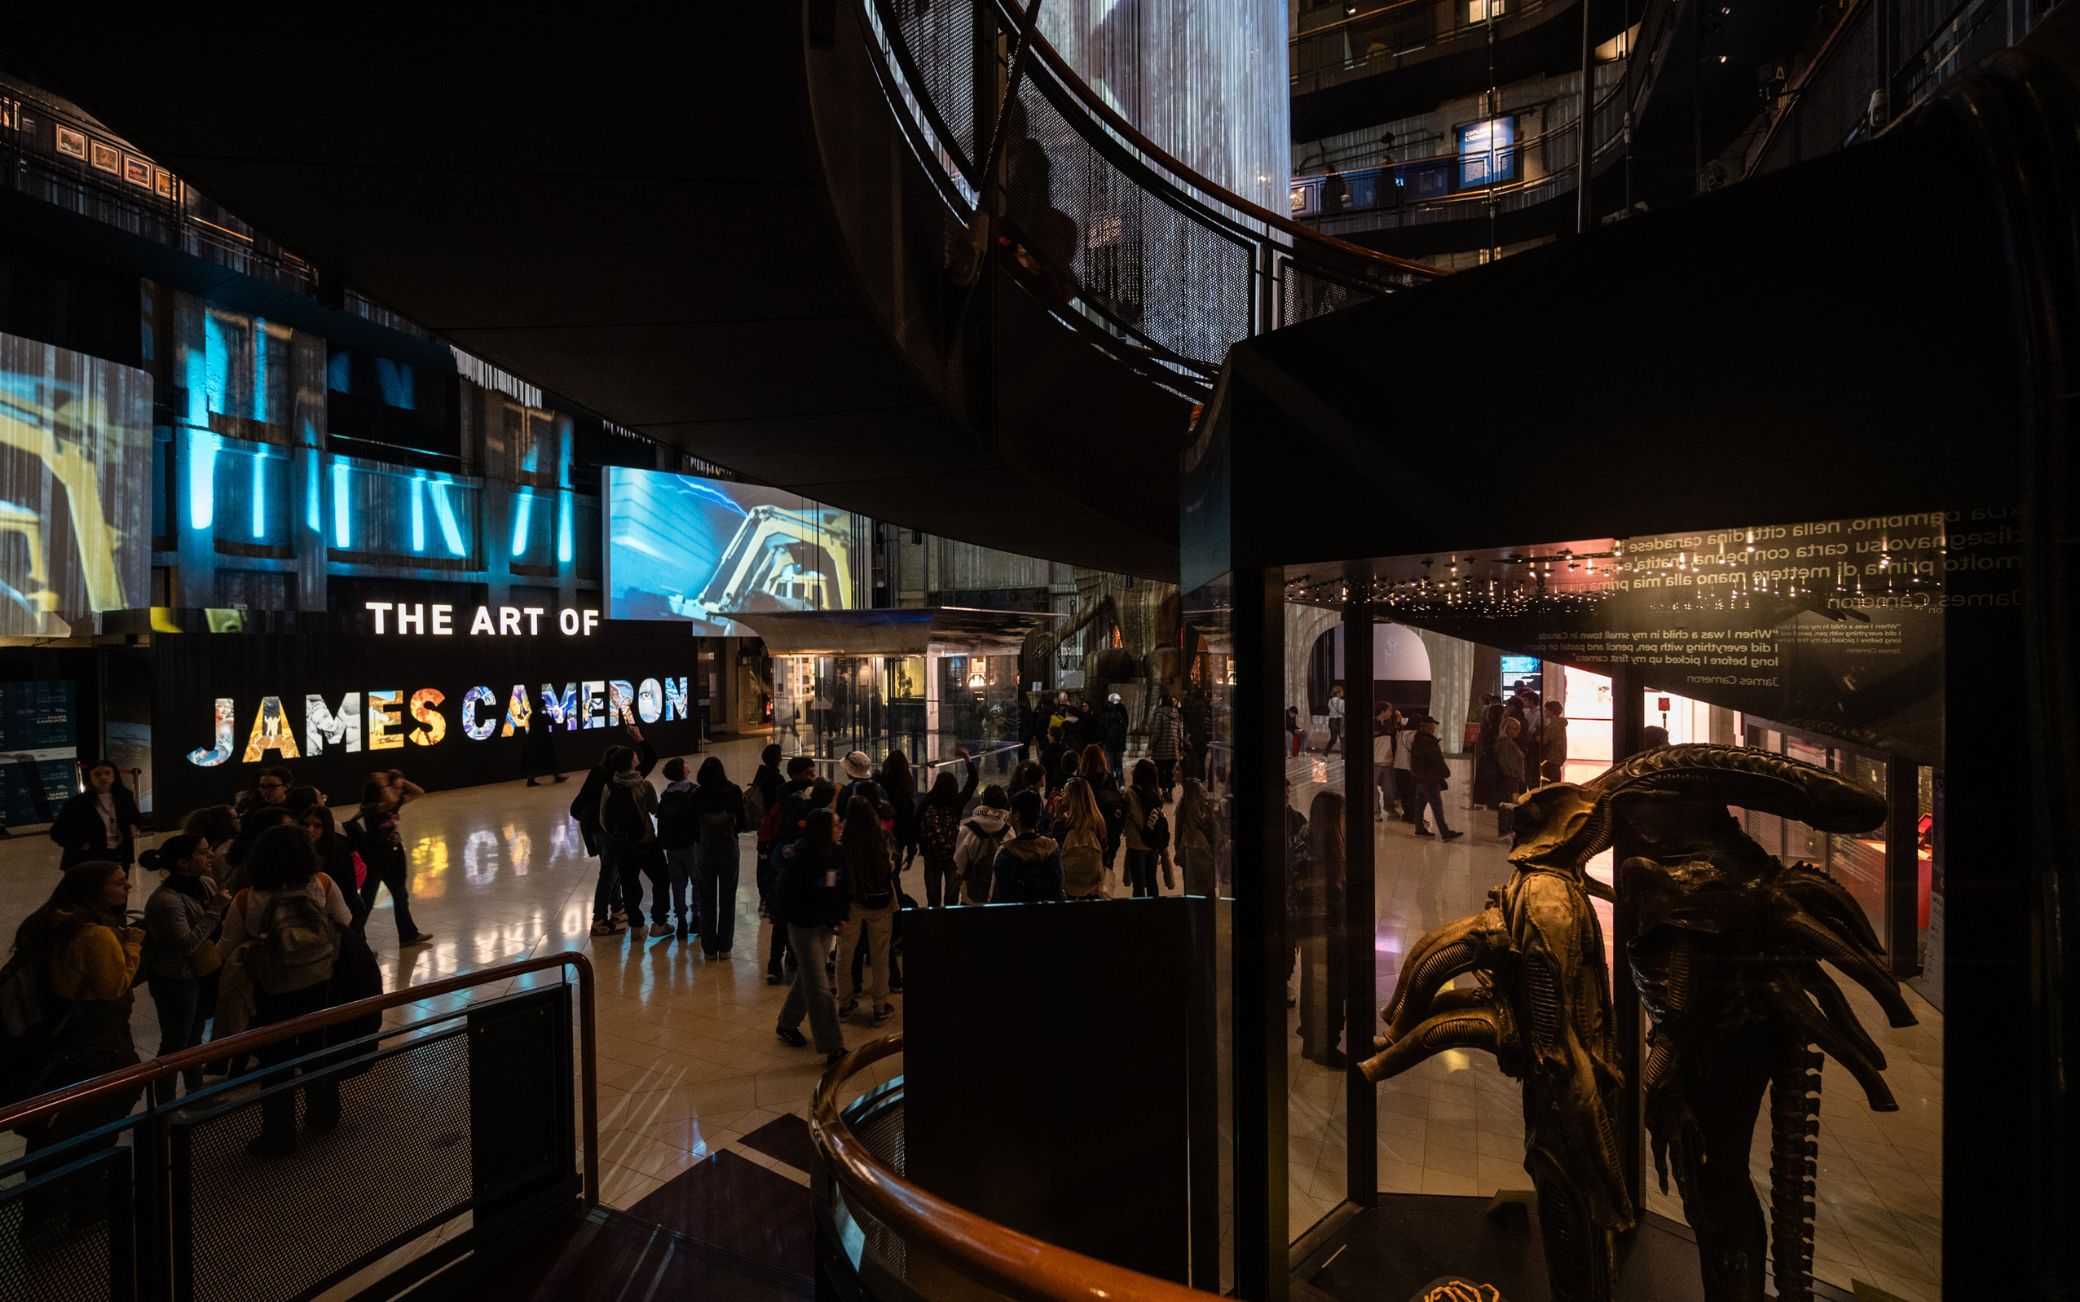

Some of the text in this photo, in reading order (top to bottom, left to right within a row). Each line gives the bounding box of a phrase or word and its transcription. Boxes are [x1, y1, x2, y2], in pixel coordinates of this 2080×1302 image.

[366, 602, 600, 637] THE ART OF
[185, 676, 689, 767] JAMES CAMERON
